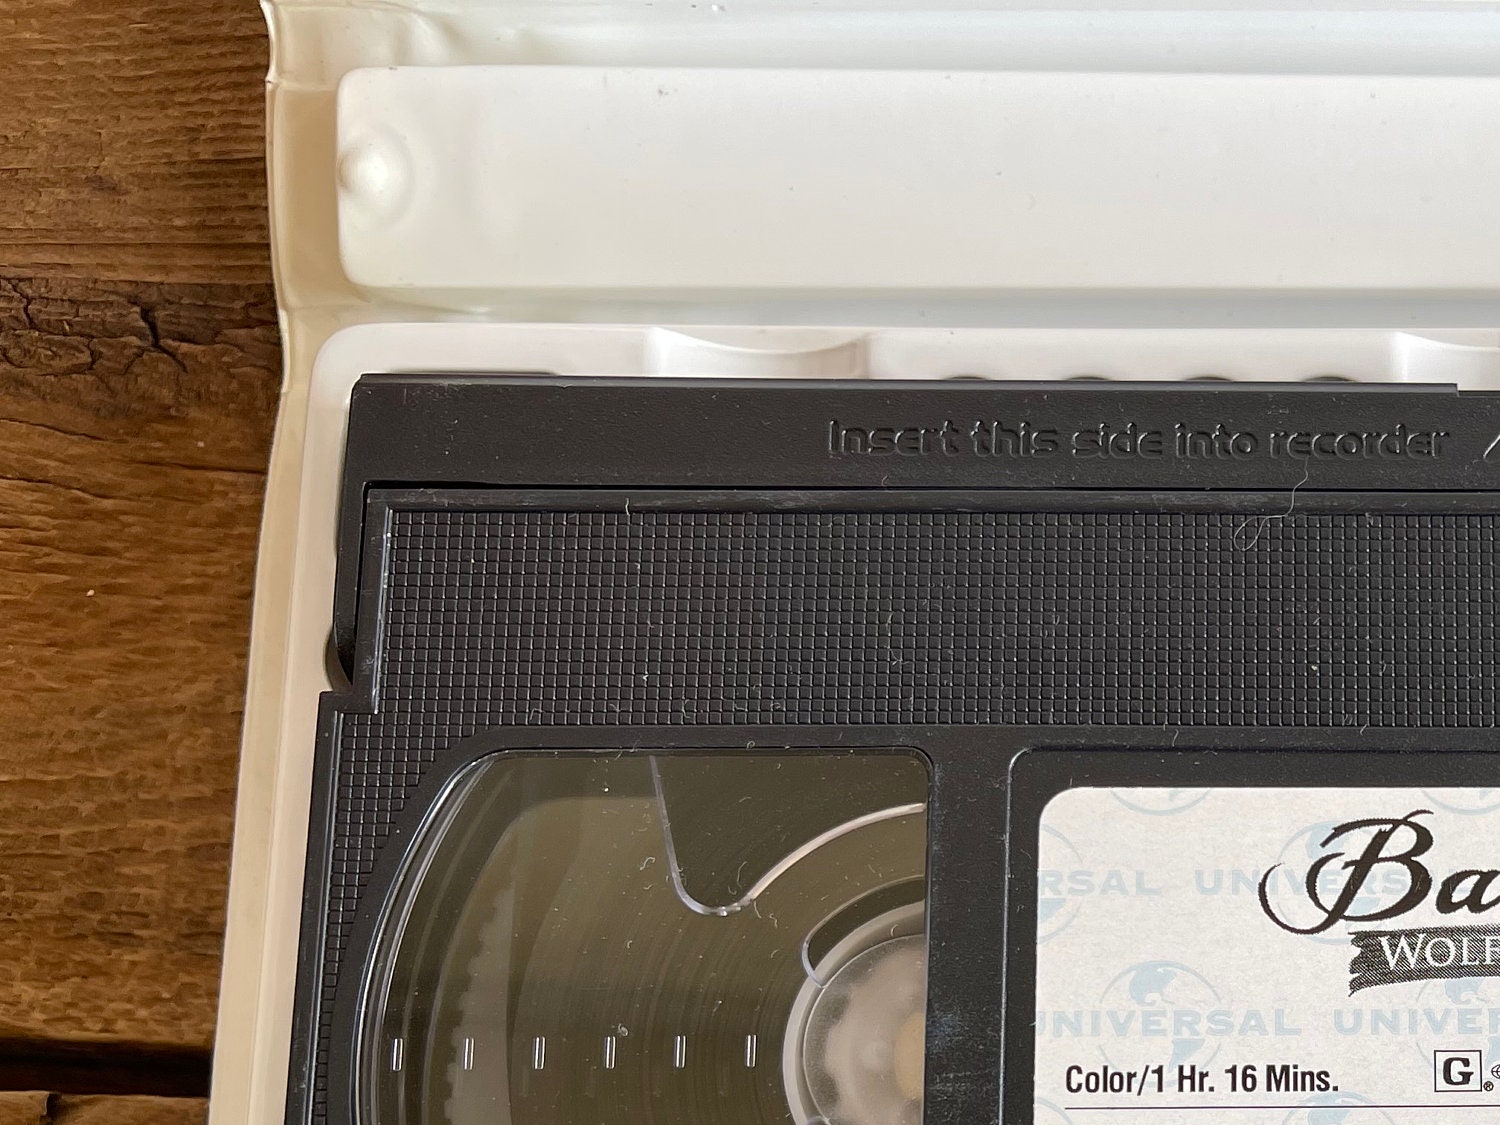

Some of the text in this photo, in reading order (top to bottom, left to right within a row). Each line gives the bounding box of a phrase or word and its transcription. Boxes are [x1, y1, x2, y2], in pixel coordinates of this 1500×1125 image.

[828, 419, 1450, 460] Insert this side into recorder
[1065, 1064, 1339, 1097] Color/1 Hr. 16 Mins.
[1442, 1056, 1475, 1086] G
